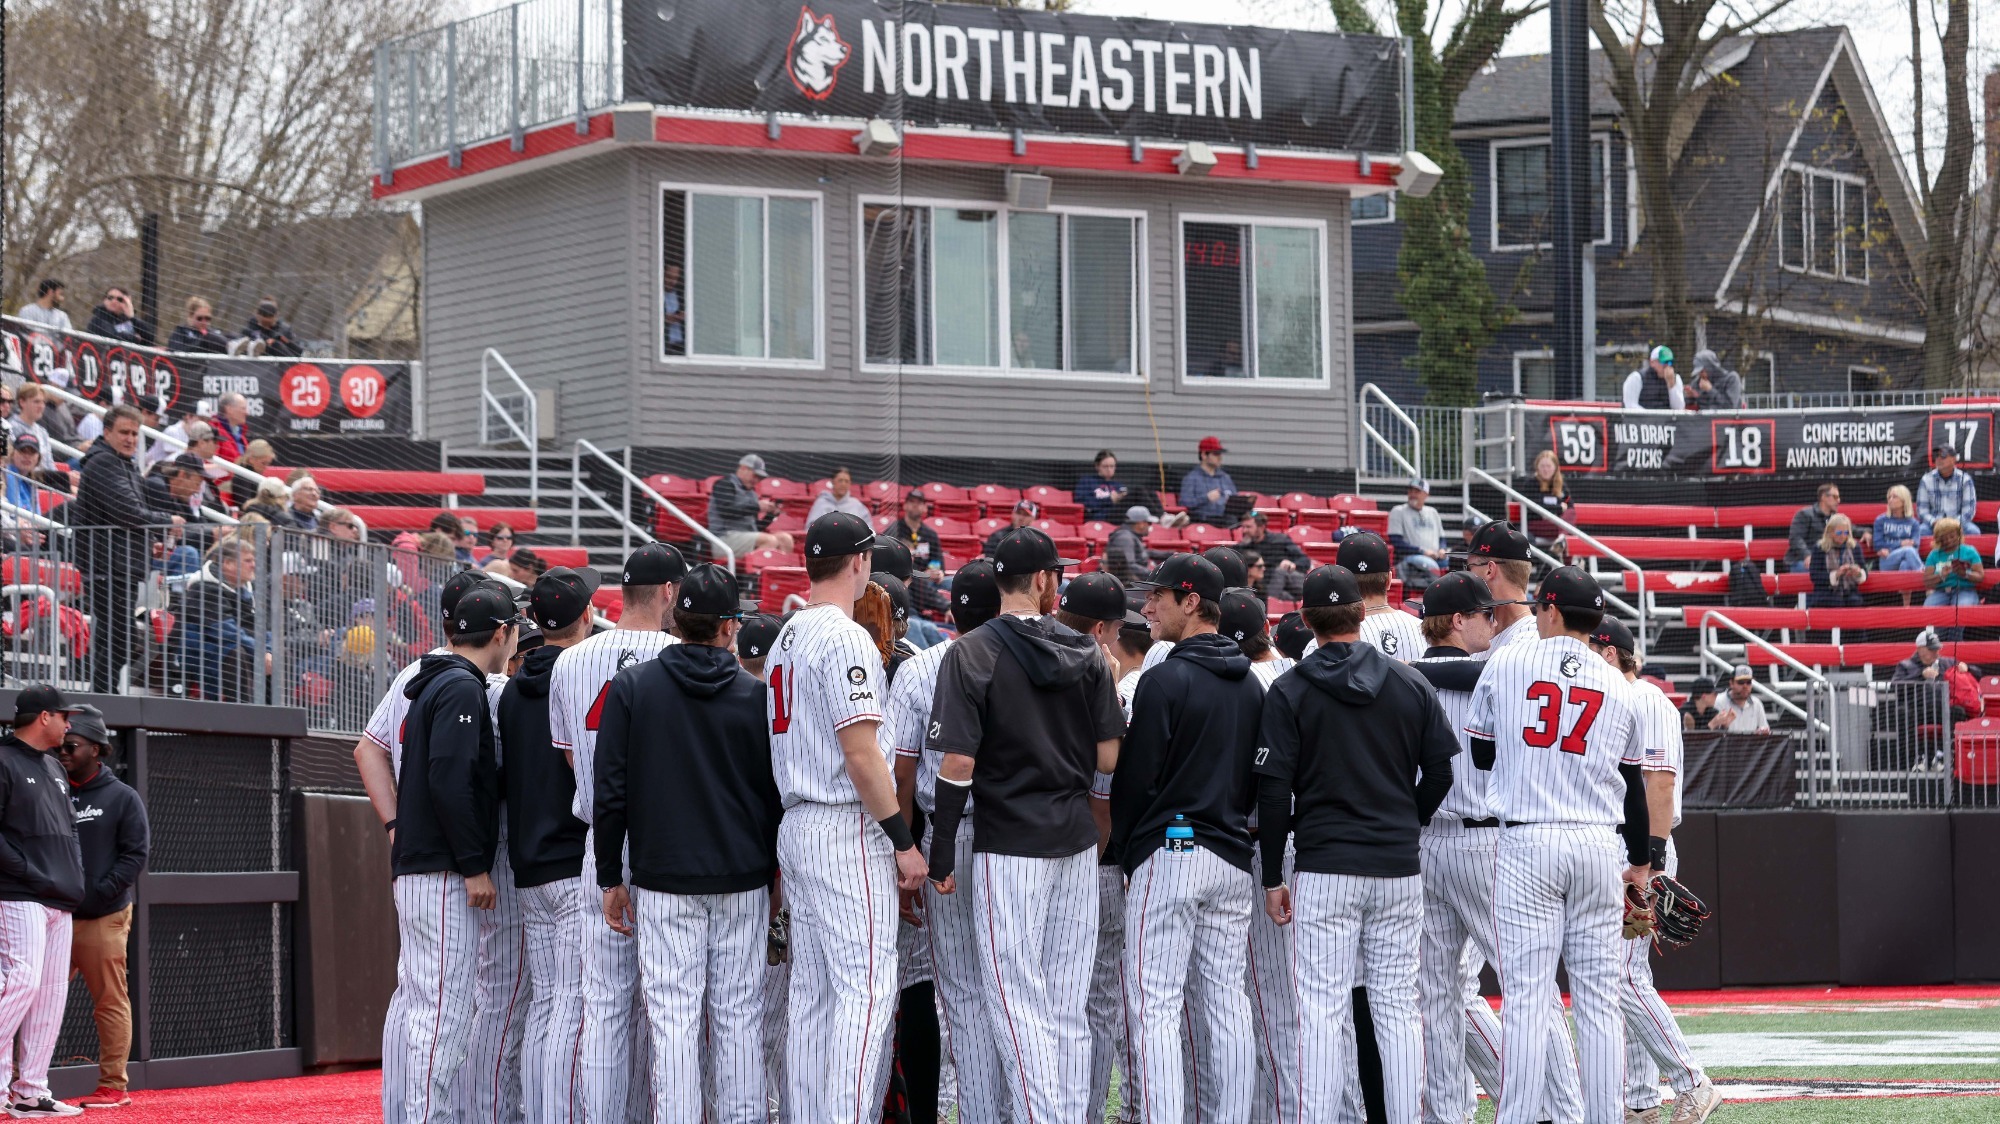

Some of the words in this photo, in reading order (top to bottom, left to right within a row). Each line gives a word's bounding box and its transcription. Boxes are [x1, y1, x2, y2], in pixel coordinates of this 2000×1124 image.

[861, 19, 1262, 120] NORTHEASTERN
[202, 375, 259, 395] RETIRED
[291, 375, 321, 407] 25
[348, 376, 378, 408] 30
[1560, 424, 1596, 465] 59
[1640, 425, 1677, 446] DRAFT
[1802, 421, 1895, 444] CONFERENCE
[1944, 420, 1979, 462] 17
[1626, 448, 1663, 470] PICKS
[1724, 426, 1762, 468] 18
[1786, 446, 1838, 469] AWARD
[1841, 445, 1912, 469] WINNERS
[849, 691, 874, 702] CAA
[1522, 680, 1605, 757] 37
[1254, 747, 1270, 766] 27
